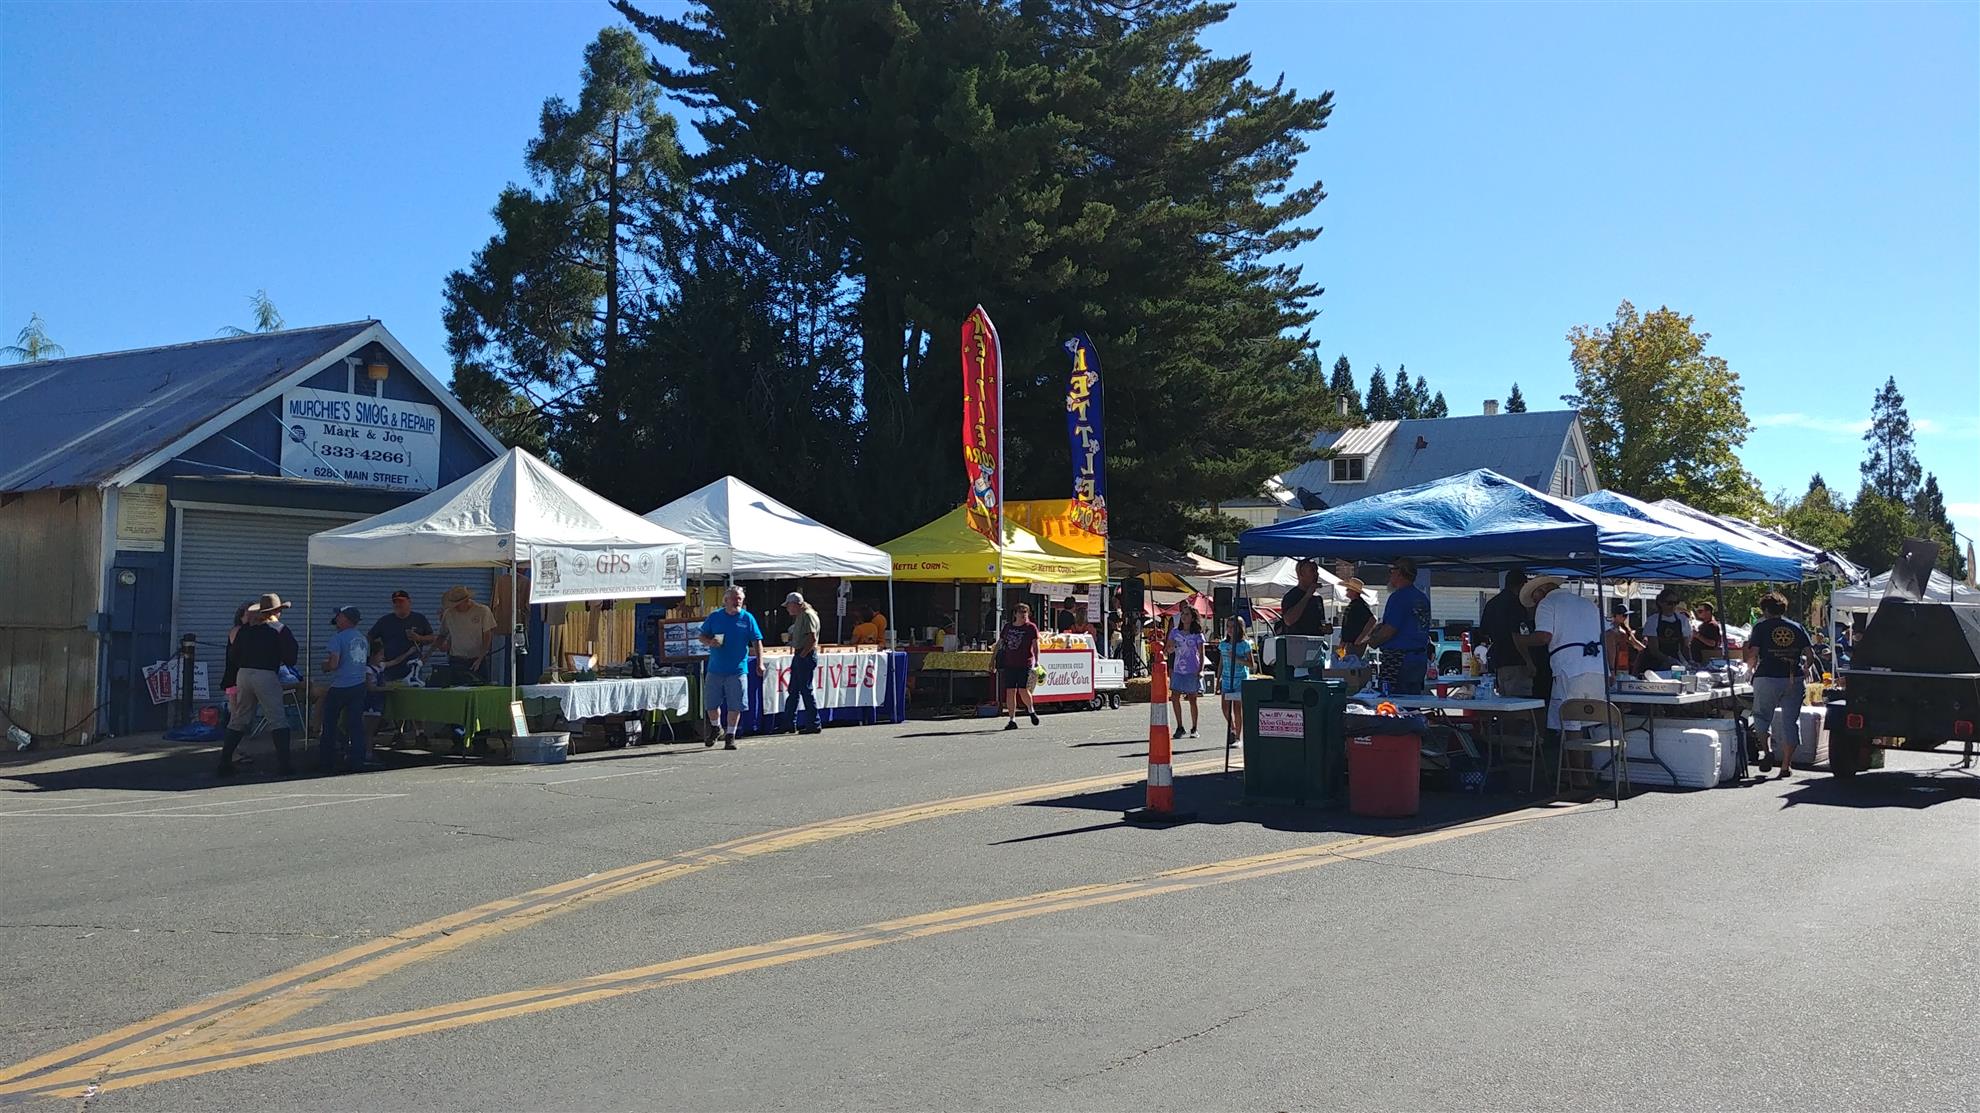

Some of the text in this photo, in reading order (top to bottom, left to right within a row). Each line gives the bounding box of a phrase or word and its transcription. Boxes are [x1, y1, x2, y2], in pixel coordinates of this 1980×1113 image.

[289, 399, 435, 432] MURCHIE'S SMOG & REPAIR
[323, 424, 404, 444] Mark & Joe
[344, 469, 369, 481] MAIN
[373, 472, 409, 485] STREET
[596, 553, 631, 575] GPS
[776, 662, 876, 693] KIVES
[1047, 670, 1090, 686] Kettle Corn
